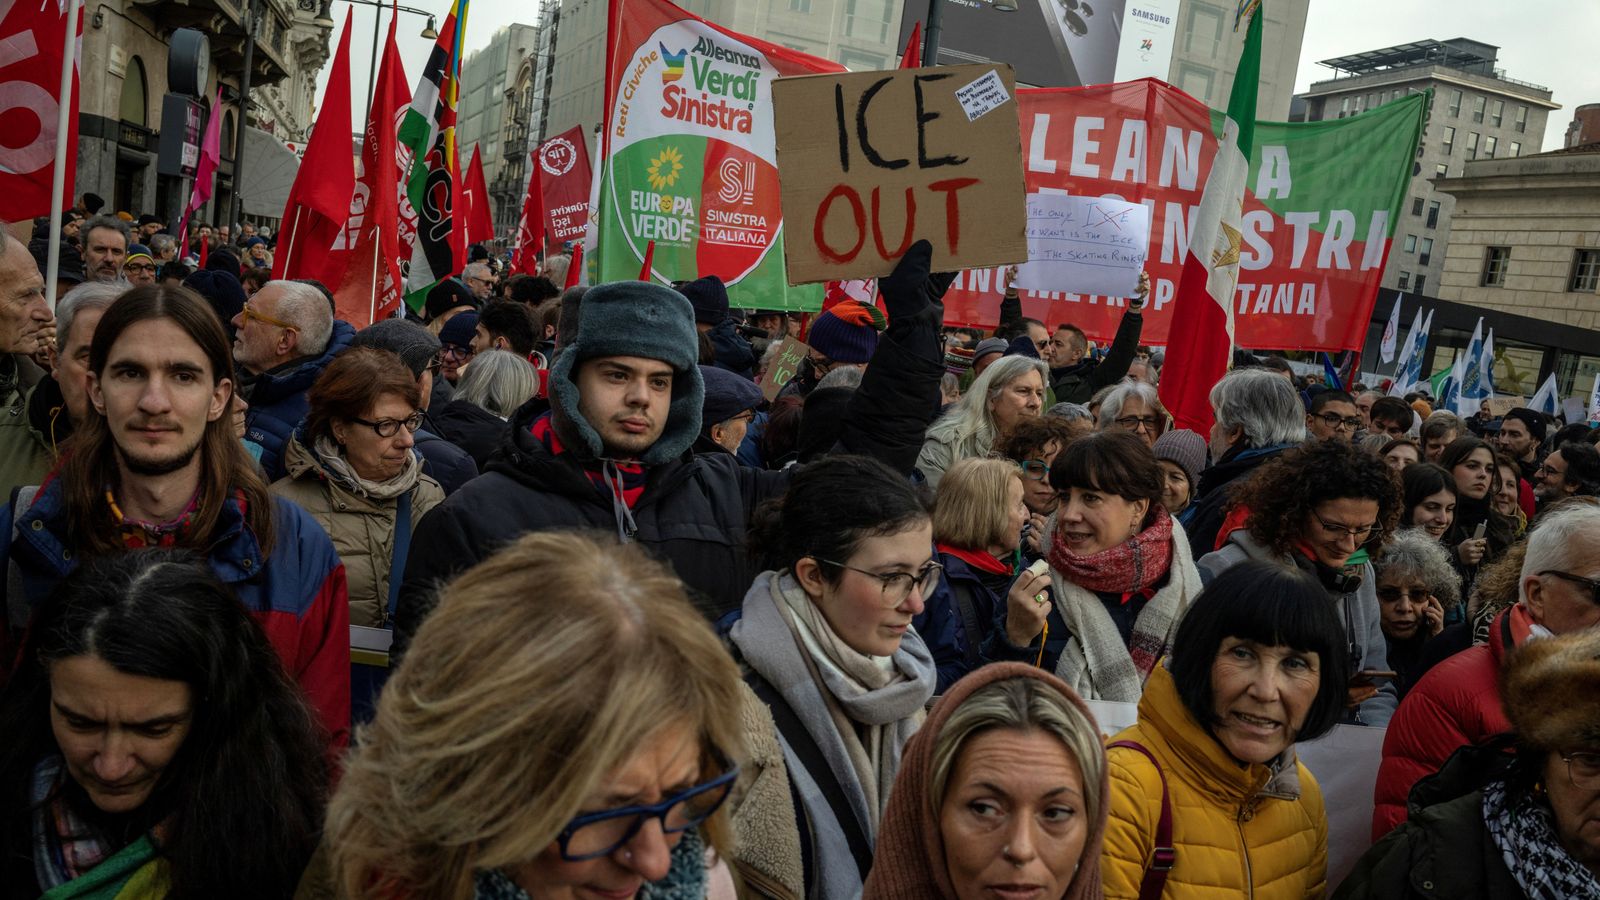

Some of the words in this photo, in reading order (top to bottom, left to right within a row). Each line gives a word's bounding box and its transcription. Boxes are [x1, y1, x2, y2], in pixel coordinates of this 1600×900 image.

[1132, 8, 1171, 24] SAMSUNG
[691, 36, 761, 70] Alleanza
[691, 56, 760, 102] Verdi
[616, 102, 629, 138] Reti
[624, 50, 658, 100] Civiche
[660, 84, 752, 134] Sinistra
[835, 73, 969, 173] ICE
[631, 213, 695, 242] VERDE
[706, 209, 767, 227] SINISTRA
[813, 177, 982, 264] OUT
[706, 227, 767, 245] ITALIANA
[1040, 229, 1064, 237] WANT
[1068, 250, 1107, 260] SKATING
[773, 367, 795, 386] IC
